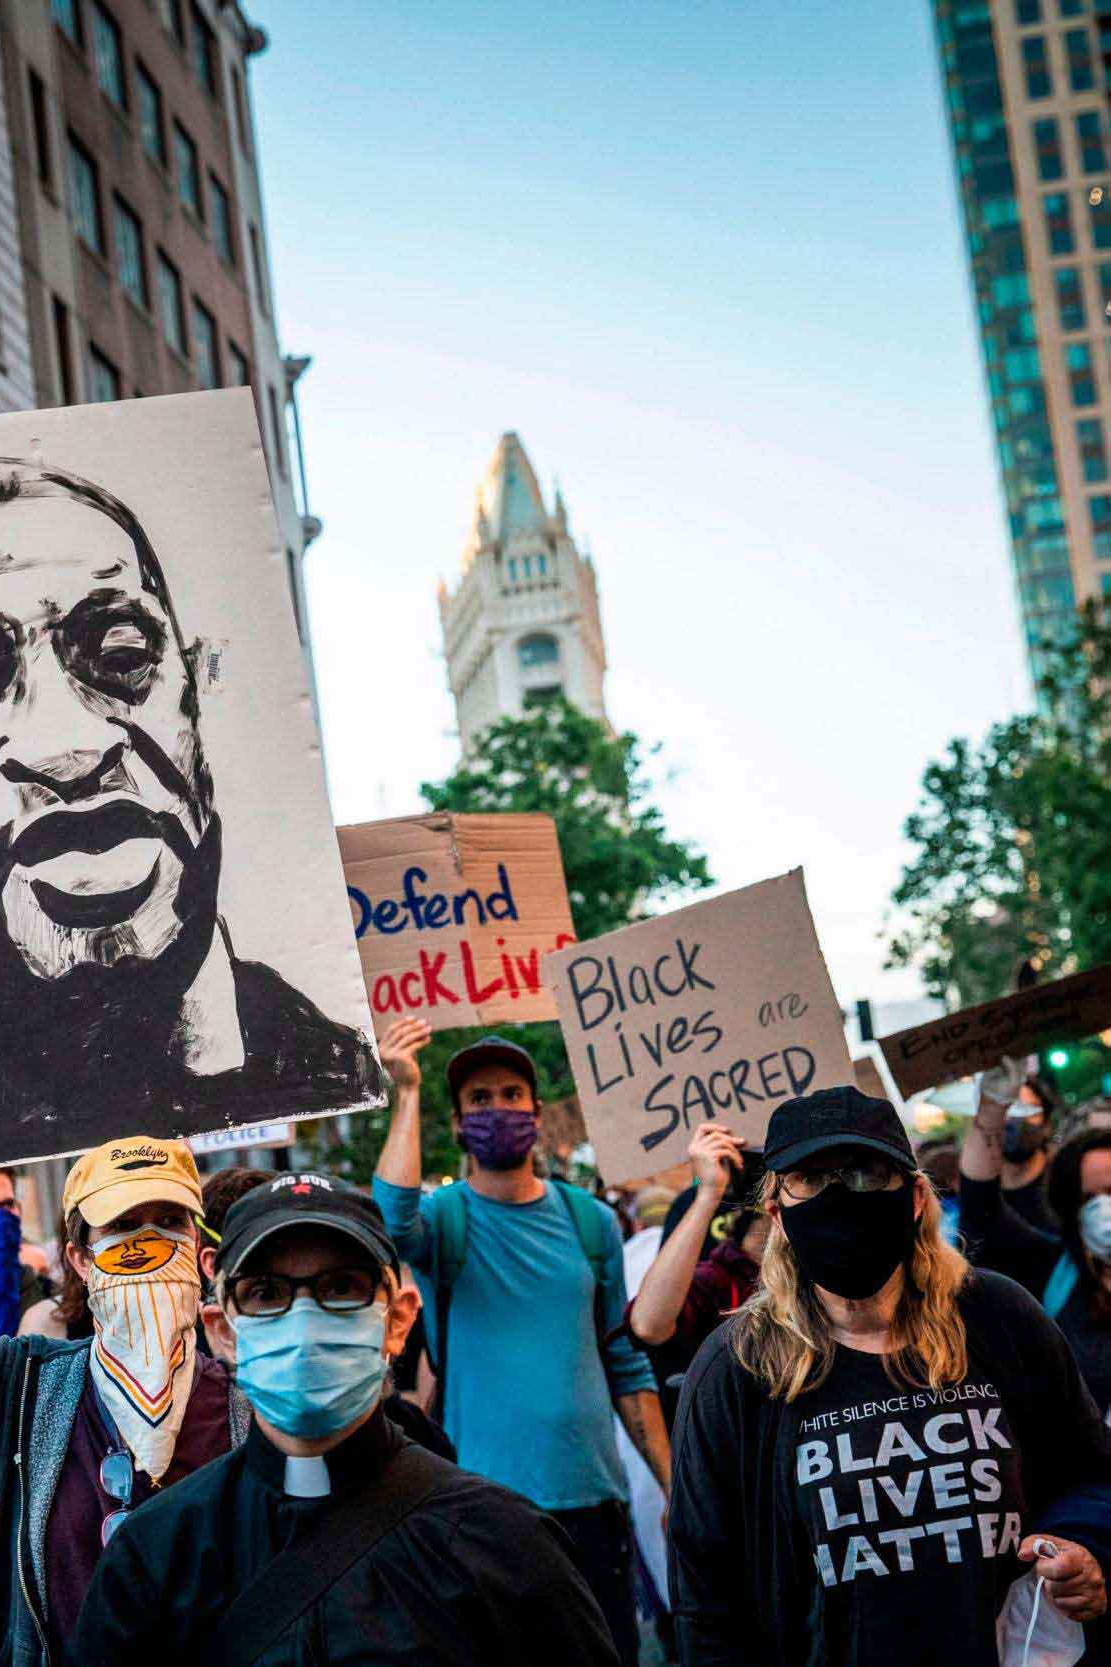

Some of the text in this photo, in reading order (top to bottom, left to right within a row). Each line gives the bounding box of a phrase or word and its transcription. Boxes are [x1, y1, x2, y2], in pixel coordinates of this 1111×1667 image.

[346, 863, 518, 939] Defend
[372, 934, 577, 1013] ack Liv
[567, 939, 715, 1031] Black
[586, 992, 808, 1094] Lives are
[640, 1046, 816, 1152] SACRED
[110, 1145, 169, 1162] Brooklyn
[796, 1408, 1011, 1487] BLACK
[798, 1383, 999, 1435] HITE SILENCE IS VIOLENC
[819, 1459, 1001, 1531] LIVES
